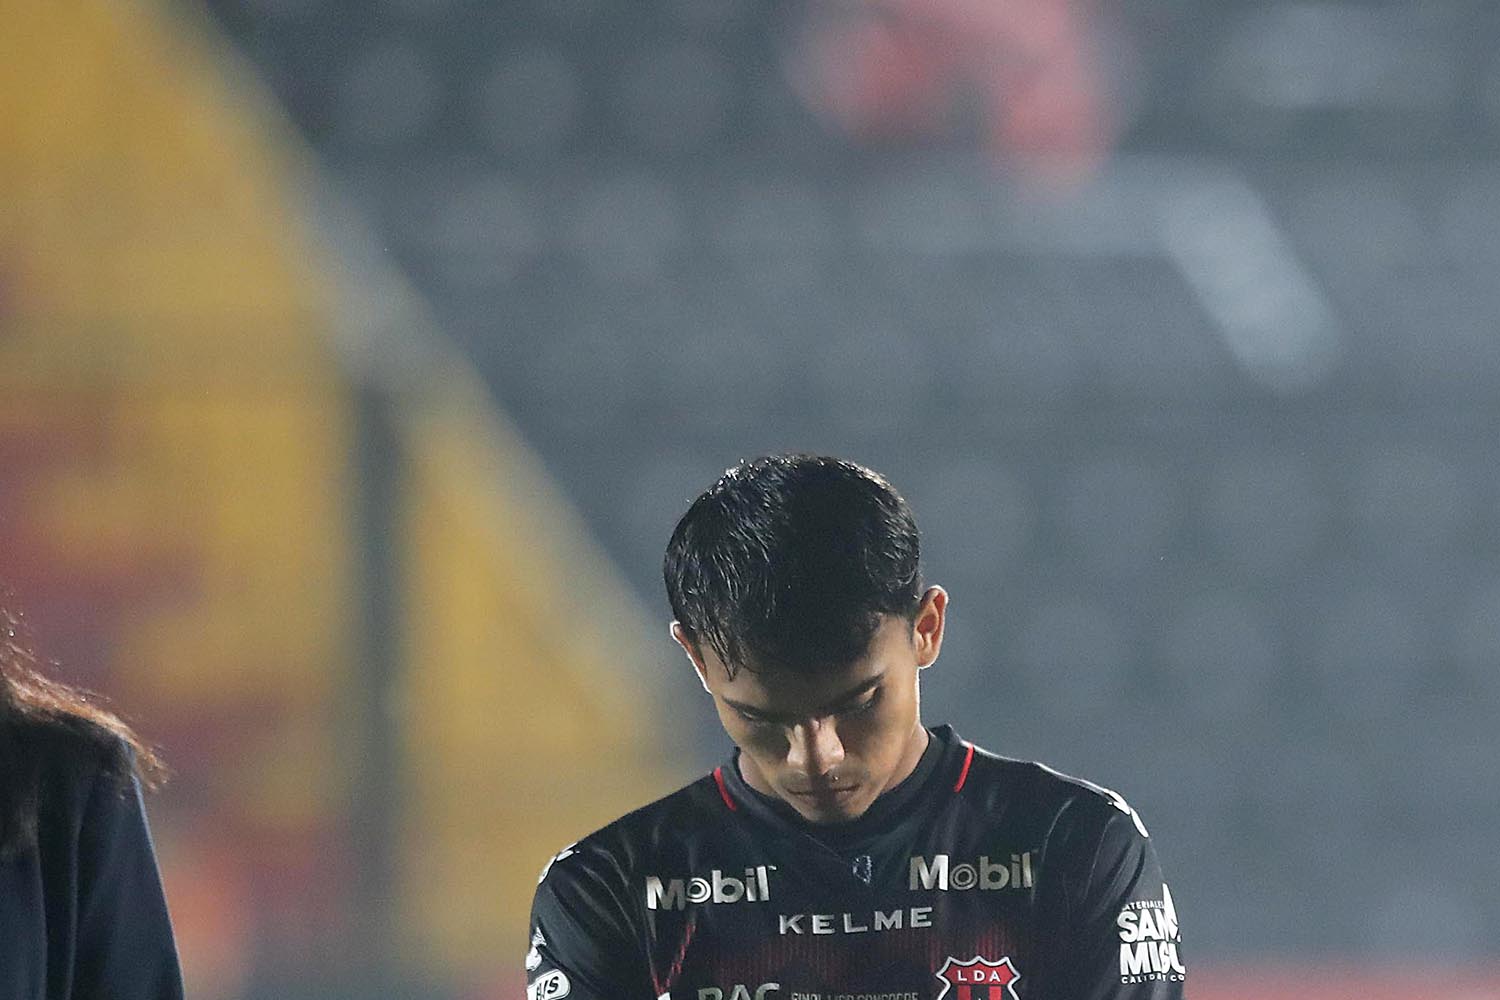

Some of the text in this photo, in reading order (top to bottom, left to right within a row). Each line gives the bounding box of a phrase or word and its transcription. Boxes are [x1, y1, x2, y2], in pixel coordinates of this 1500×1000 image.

[646, 866, 770, 910] Mobil
[909, 852, 1033, 891] Mobil
[779, 907, 933, 936] KELME
[957, 970, 1001, 982] LDA
